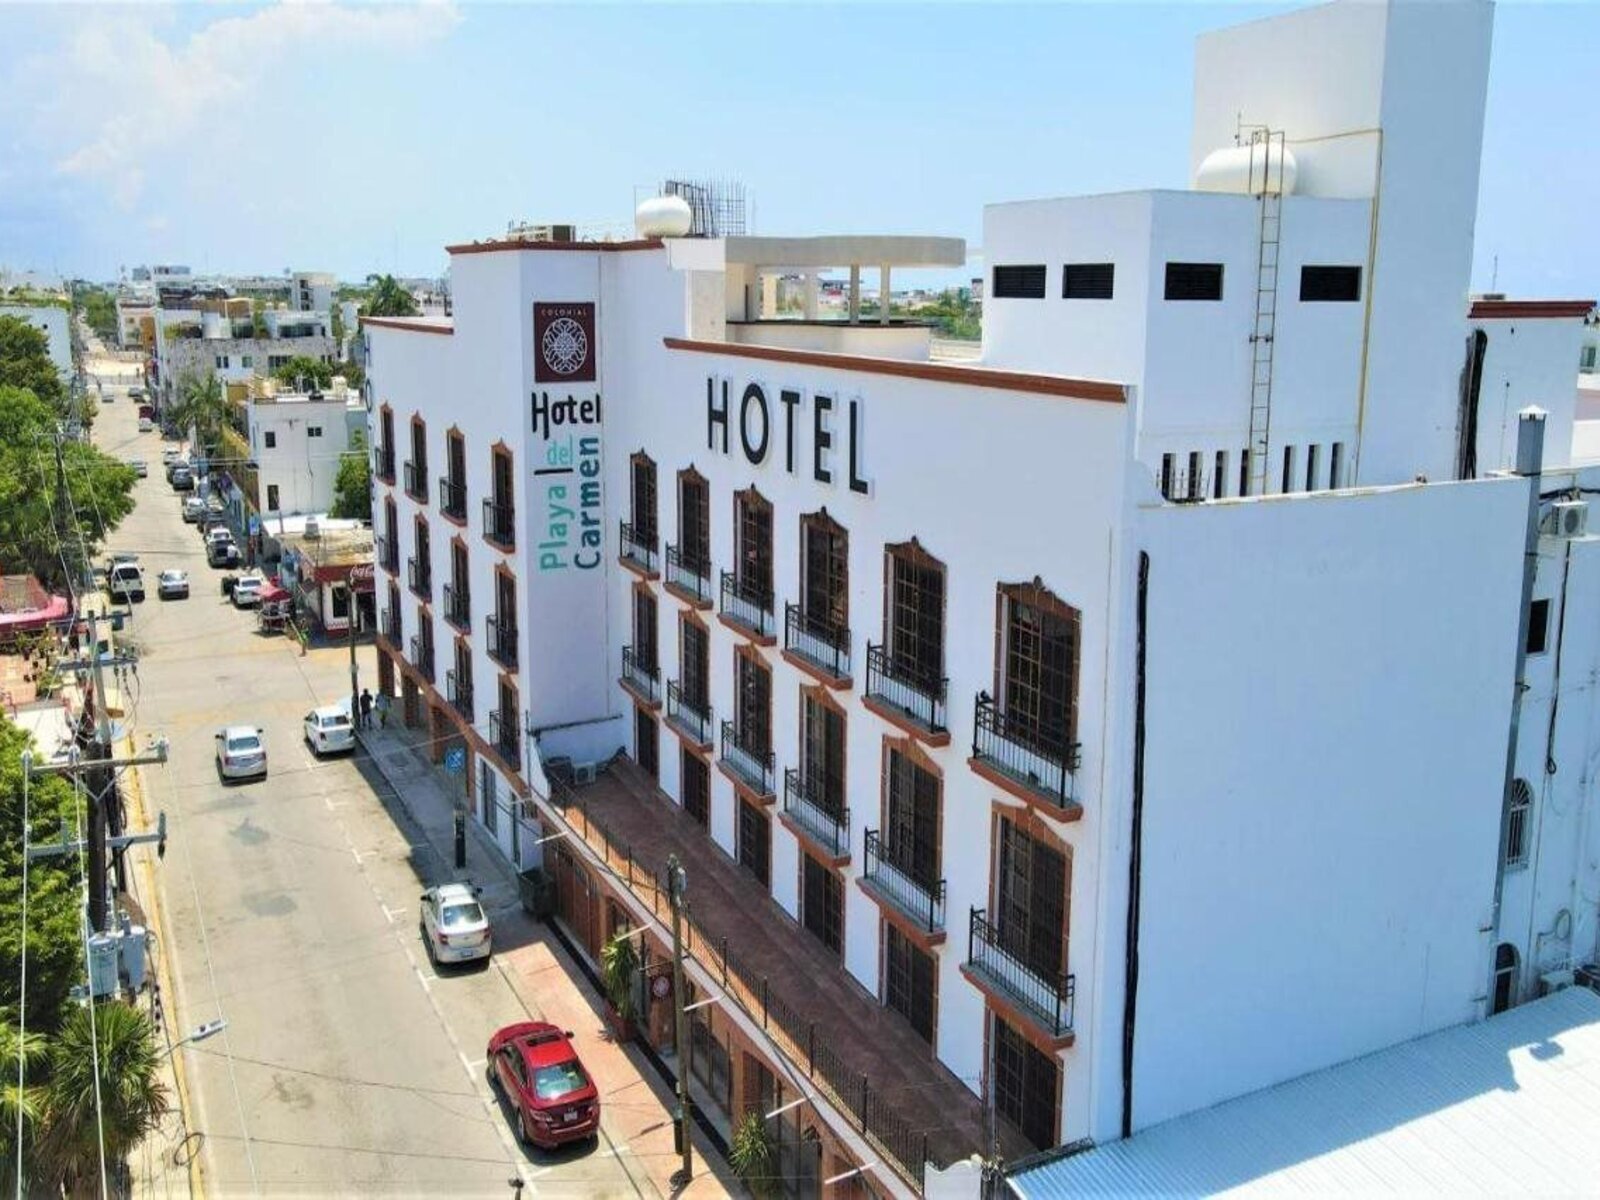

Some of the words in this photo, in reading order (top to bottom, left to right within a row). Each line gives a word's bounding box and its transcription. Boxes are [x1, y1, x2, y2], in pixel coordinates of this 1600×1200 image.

[541, 308, 588, 316] COLONIAL
[531, 392, 602, 440] Hotel
[547, 434, 573, 465] del
[707, 378, 869, 495] HOTEL
[538, 485, 576, 571] Playa
[574, 436, 601, 571] Carmen
